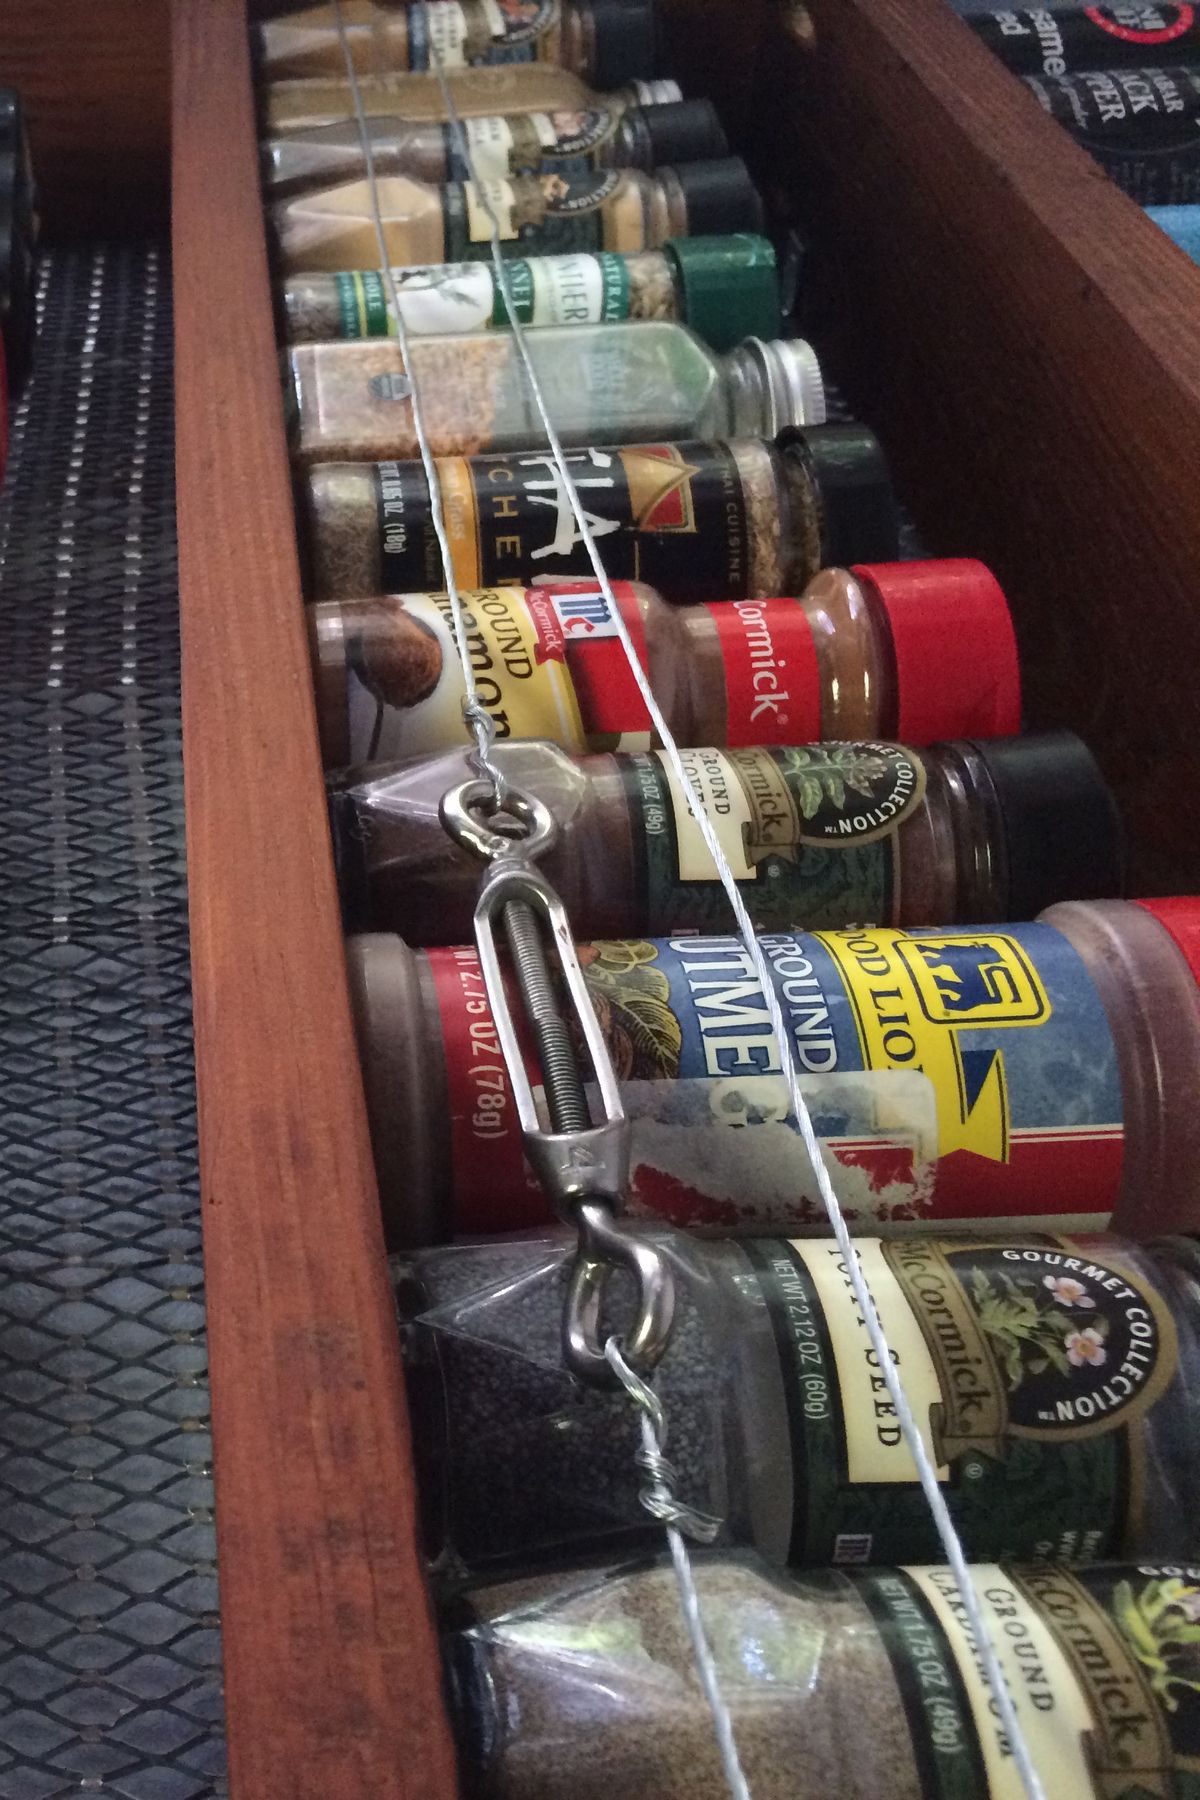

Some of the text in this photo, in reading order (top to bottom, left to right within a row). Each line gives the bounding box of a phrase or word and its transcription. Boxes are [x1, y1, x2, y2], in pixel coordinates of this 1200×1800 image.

[382, 522, 408, 555] (18g)
[724, 501, 743, 584] CUISINE
[641, 785, 661, 800] OZ
[642, 803, 666, 836] (49g)
[698, 751, 731, 815] GROUND
[731, 750, 790, 832] Cormick
[837, 761, 914, 834] COLLECTION
[468, 1021, 501, 1057] OZ
[754, 932, 839, 1074] GROUND
[467, 1064, 510, 1140] (78g)
[1001, 1249, 1137, 1301] GOURMET
[771, 1259, 830, 1421] NET WT 2.12 OZ (60g)
[894, 1243, 991, 1419] McCormick
[1055, 1306, 1153, 1421] COLLECTION
[863, 1347, 902, 1448] SEED
[903, 1623, 937, 1658] 1.75
[918, 1660, 950, 1688] OZ
[983, 1587, 1055, 1714] GROUND
[923, 1696, 964, 1754] (49g)
